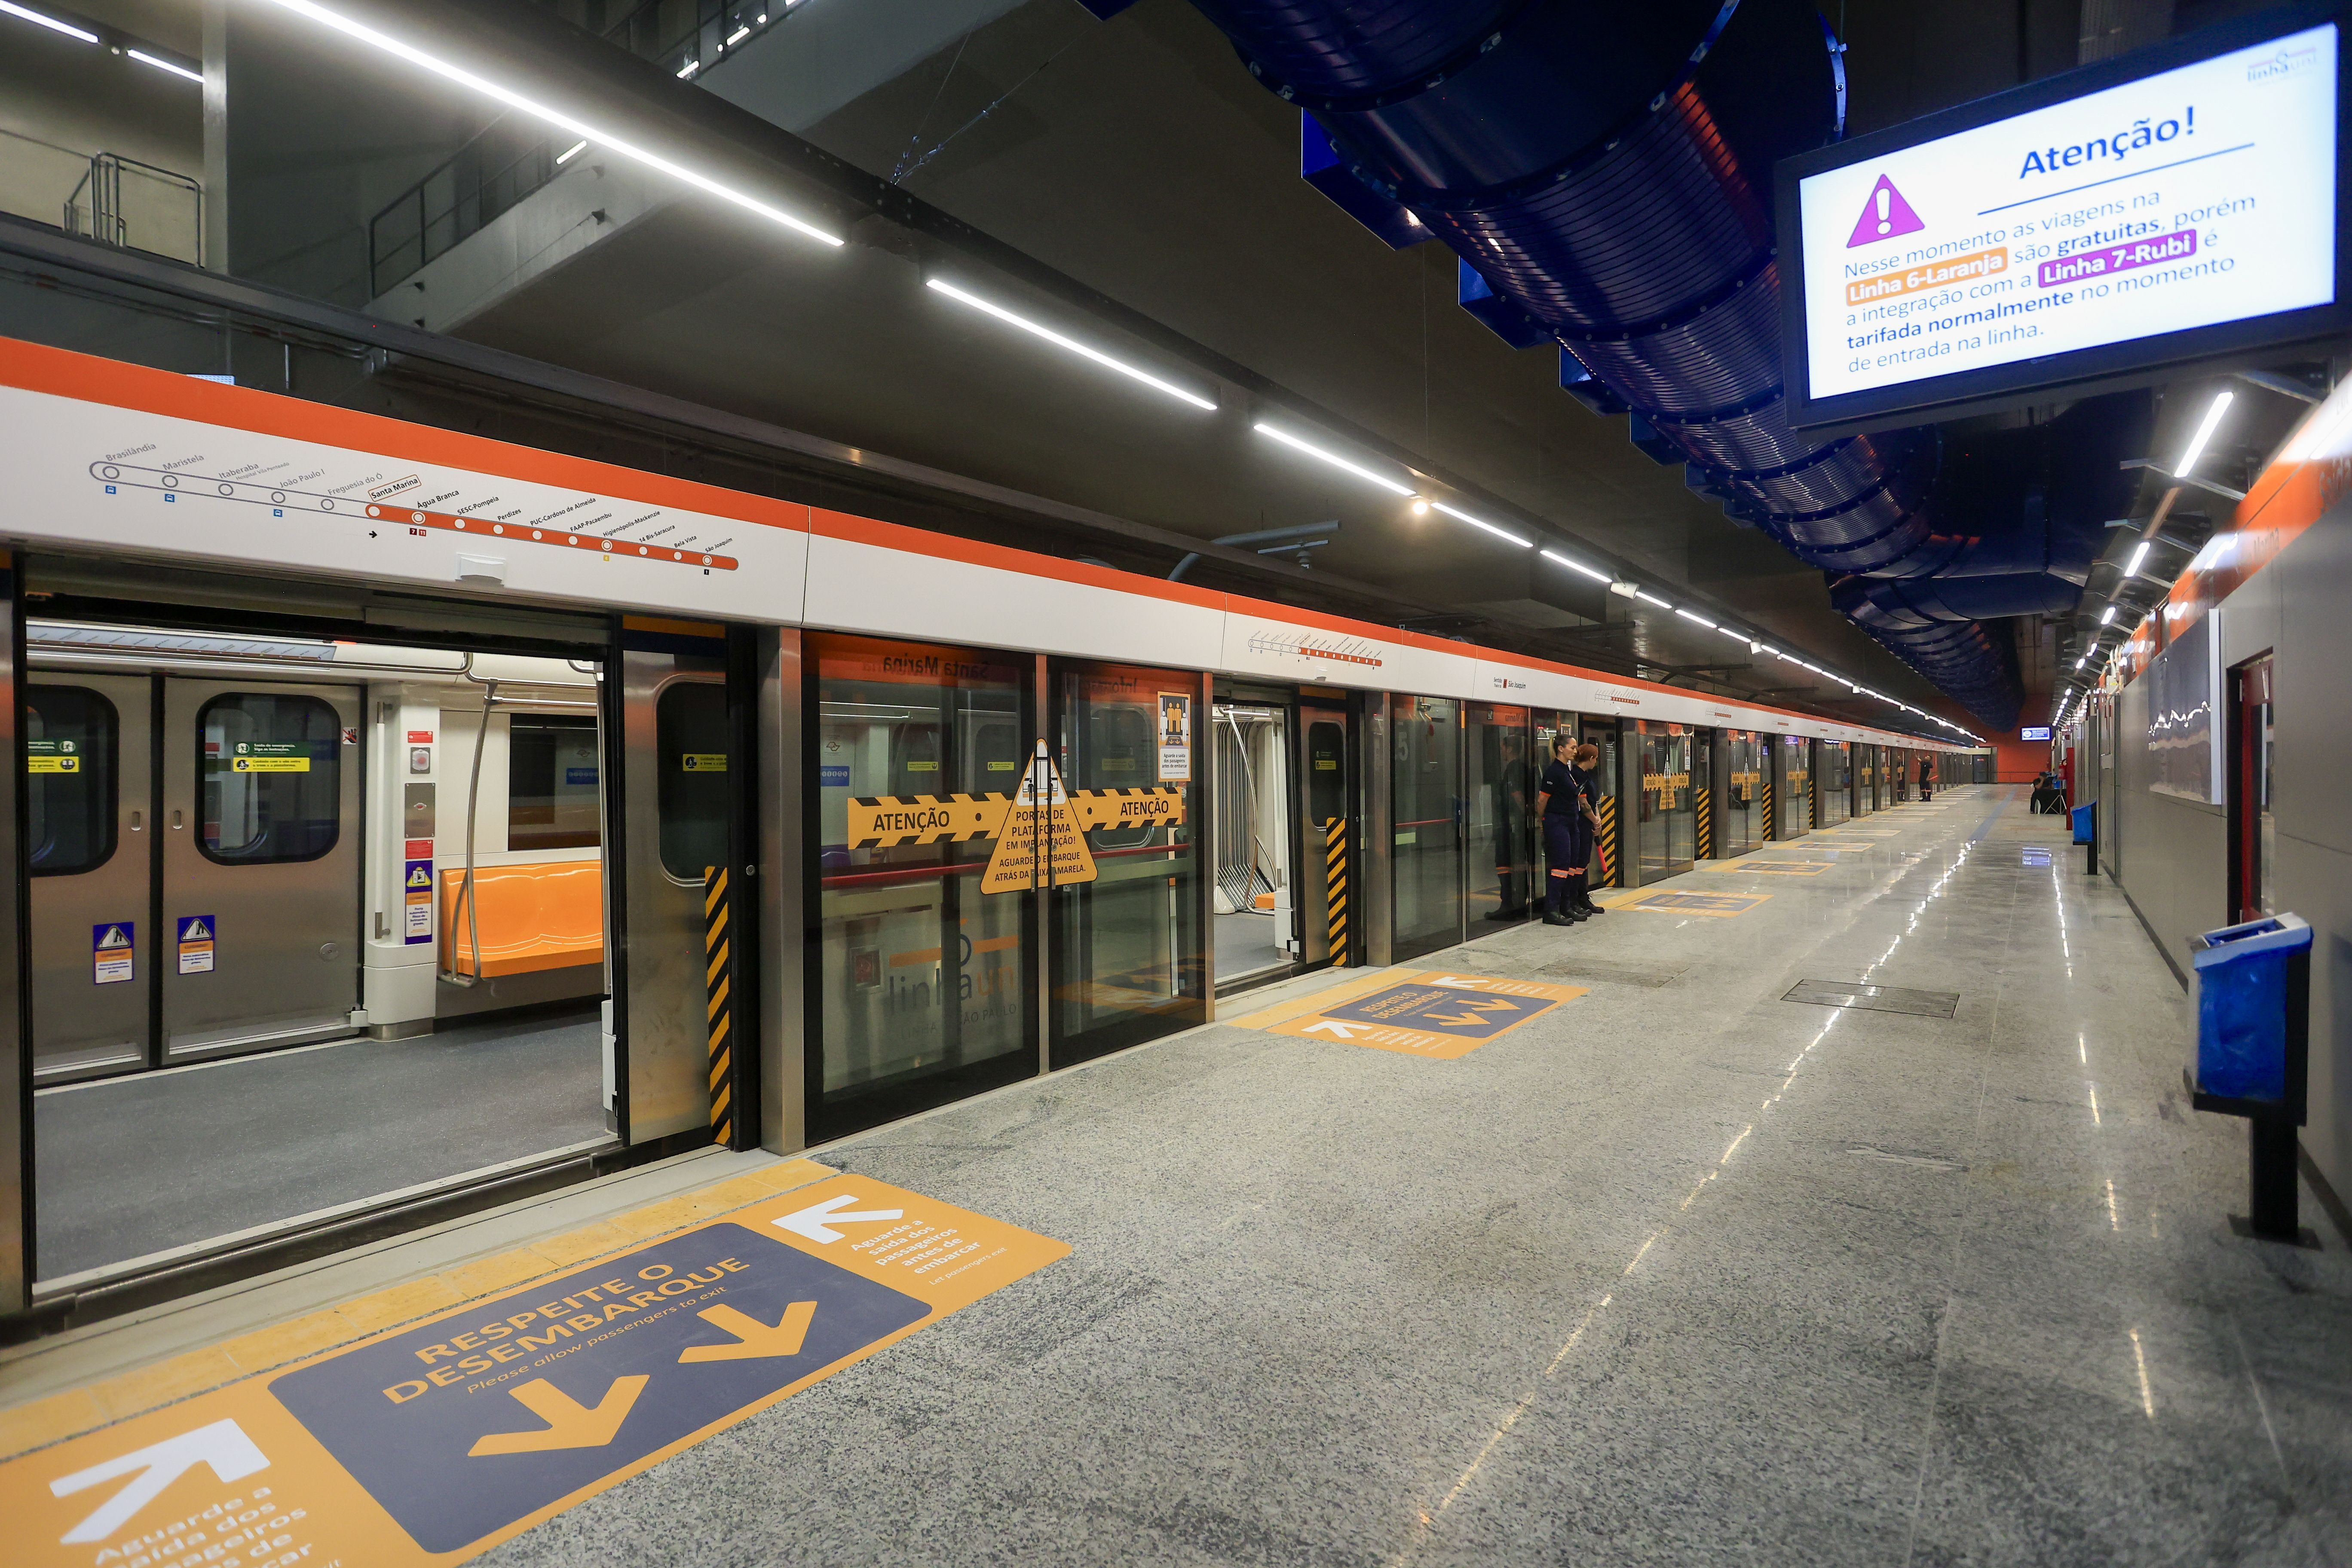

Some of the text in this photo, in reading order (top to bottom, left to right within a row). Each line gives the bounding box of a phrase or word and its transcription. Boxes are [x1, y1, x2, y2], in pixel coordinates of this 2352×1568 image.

[2019, 106, 2194, 179] Atenção!
[1845, 192, 2160, 279] Nesse momento as viagens na
[1850, 196, 2255, 302] Linha 6-Laranja são gratuitas, porém
[1847, 228, 2219, 326] a integração com a Linha 7-Rubi é
[1847, 257, 2235, 349] tarifada normalmente no momento
[1849, 324, 2044, 372] de entrada na linha.
[106, 443, 156, 462] Brasilândia
[162, 454, 204, 471] Maristela
[218, 463, 259, 479] Itaberaba
[236, 472, 257, 481] Hospital
[279, 478, 298, 488] João
[299, 471, 321, 482] Paulo
[328, 481, 364, 496] Freguesia
[371, 478, 418, 499] Santa Marina
[417, 490, 459, 509] Água Branca
[457, 496, 499, 515] SESC-Pompeia
[497, 508, 521, 521] Perdizes
[530, 510, 566, 526] PUC-Cardoso
[574, 497, 597, 509] Almeida
[570, 513, 612, 533] FAAP-Pacaembu
[603, 510, 661, 537] Higienópolis-Mackenzie
[646, 524, 676, 540] Bis-Saracura
[685, 535, 697, 544] Vista
[714, 537, 733, 550] Joaquim
[1514, 682, 1526, 690] Joaquim
[1016, 810, 1064, 821] PORTAS DE
[1120, 797, 1169, 818] ATENÇÃO
[873, 807, 949, 833] ATENÇÃO
[1012, 823, 1071, 836] PLATAFORMA
[1006, 841, 1018, 850] EM
[999, 856, 1034, 868] AGUARDE
[1043, 852, 1080, 863] EMBARQUE
[995, 870, 1017, 882] ATRÁS
[1020, 870, 1029, 879] DA
[851, 1224, 912, 1251] Aguarde
[868, 1226, 935, 1255] saída dos
[875, 1228, 958, 1266] passageiros
[901, 1238, 963, 1266] antes de
[914, 1241, 980, 1274] embarcar
[929, 1247, 1008, 1285] Let passengers exit
[415, 1265, 674, 1364] RESPEITE O
[383, 1258, 750, 1405] DESEMBARQUE
[467, 1286, 726, 1394] Please allow passengers to exit
[95, 1499, 244, 1566] Aguarde
[253, 1487, 271, 1499] a
[216, 1503, 276, 1532] dos
